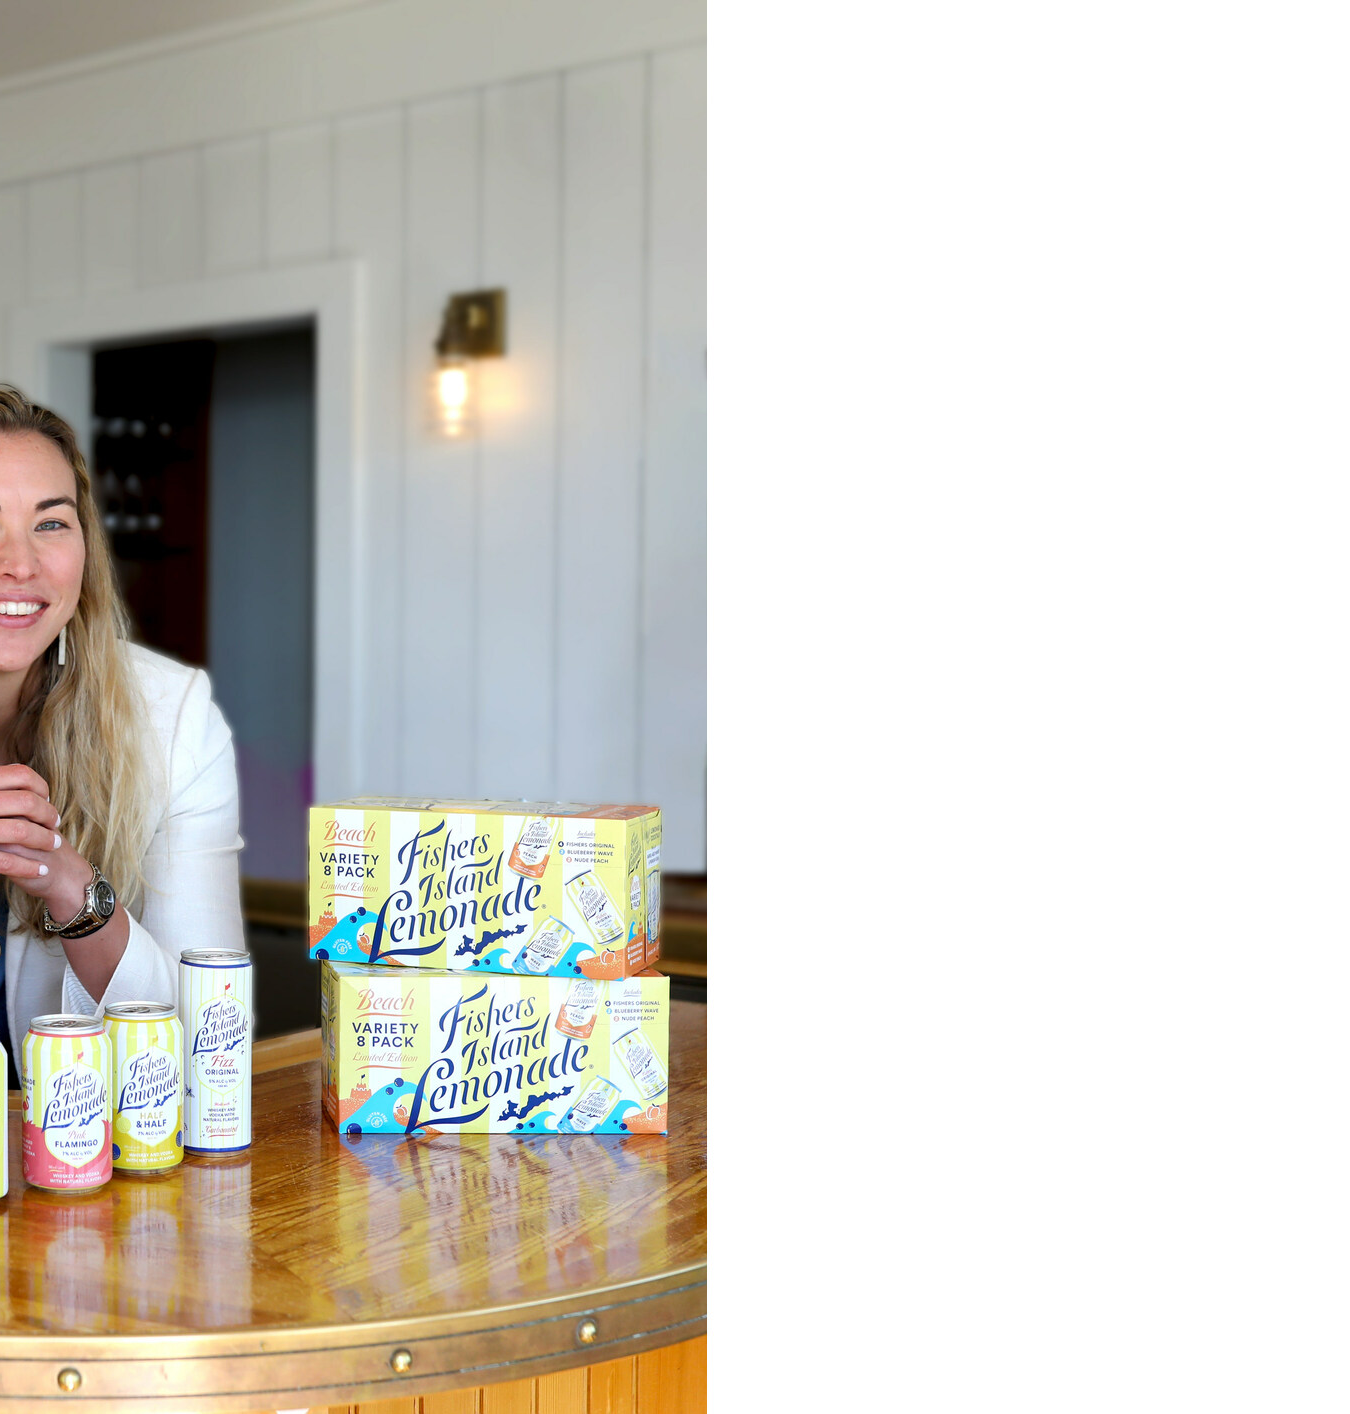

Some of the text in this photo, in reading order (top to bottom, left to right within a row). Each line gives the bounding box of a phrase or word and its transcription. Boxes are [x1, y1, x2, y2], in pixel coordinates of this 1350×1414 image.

[323, 819, 377, 842] Beach
[319, 852, 380, 865] VARIETY
[397, 818, 490, 886] Fishers
[323, 865, 375, 878] 8 PACK
[418, 850, 505, 909] Island
[320, 881, 379, 893] Limited Edition
[356, 987, 415, 1011] Beach
[202, 1001, 237, 1026] Fishers
[210, 1010, 241, 1034] Island
[438, 982, 536, 1054] Fishers
[191, 1014, 248, 1057] Lemonade
[352, 1022, 419, 1034] VARIETY
[356, 1035, 414, 1048] 8 PACK
[461, 1012, 551, 1075] Island
[129, 1052, 167, 1080] Fishers
[211, 1055, 235, 1068] Fizz
[352, 1051, 418, 1063] Limited Edition
[53, 1069, 92, 1098] Fishers
[138, 1061, 171, 1089] Island
[205, 1068, 239, 1076] ORIGINAL
[62, 1078, 97, 1108] Island
[116, 1064, 180, 1115] Lemonade
[41, 1082, 107, 1134] Lemonade
[140, 1111, 164, 1120] HALF
[67, 1130, 87, 1140] Pink
[136, 1119, 167, 1128] & HALF
[54, 1139, 98, 1148] FLAMINGO
